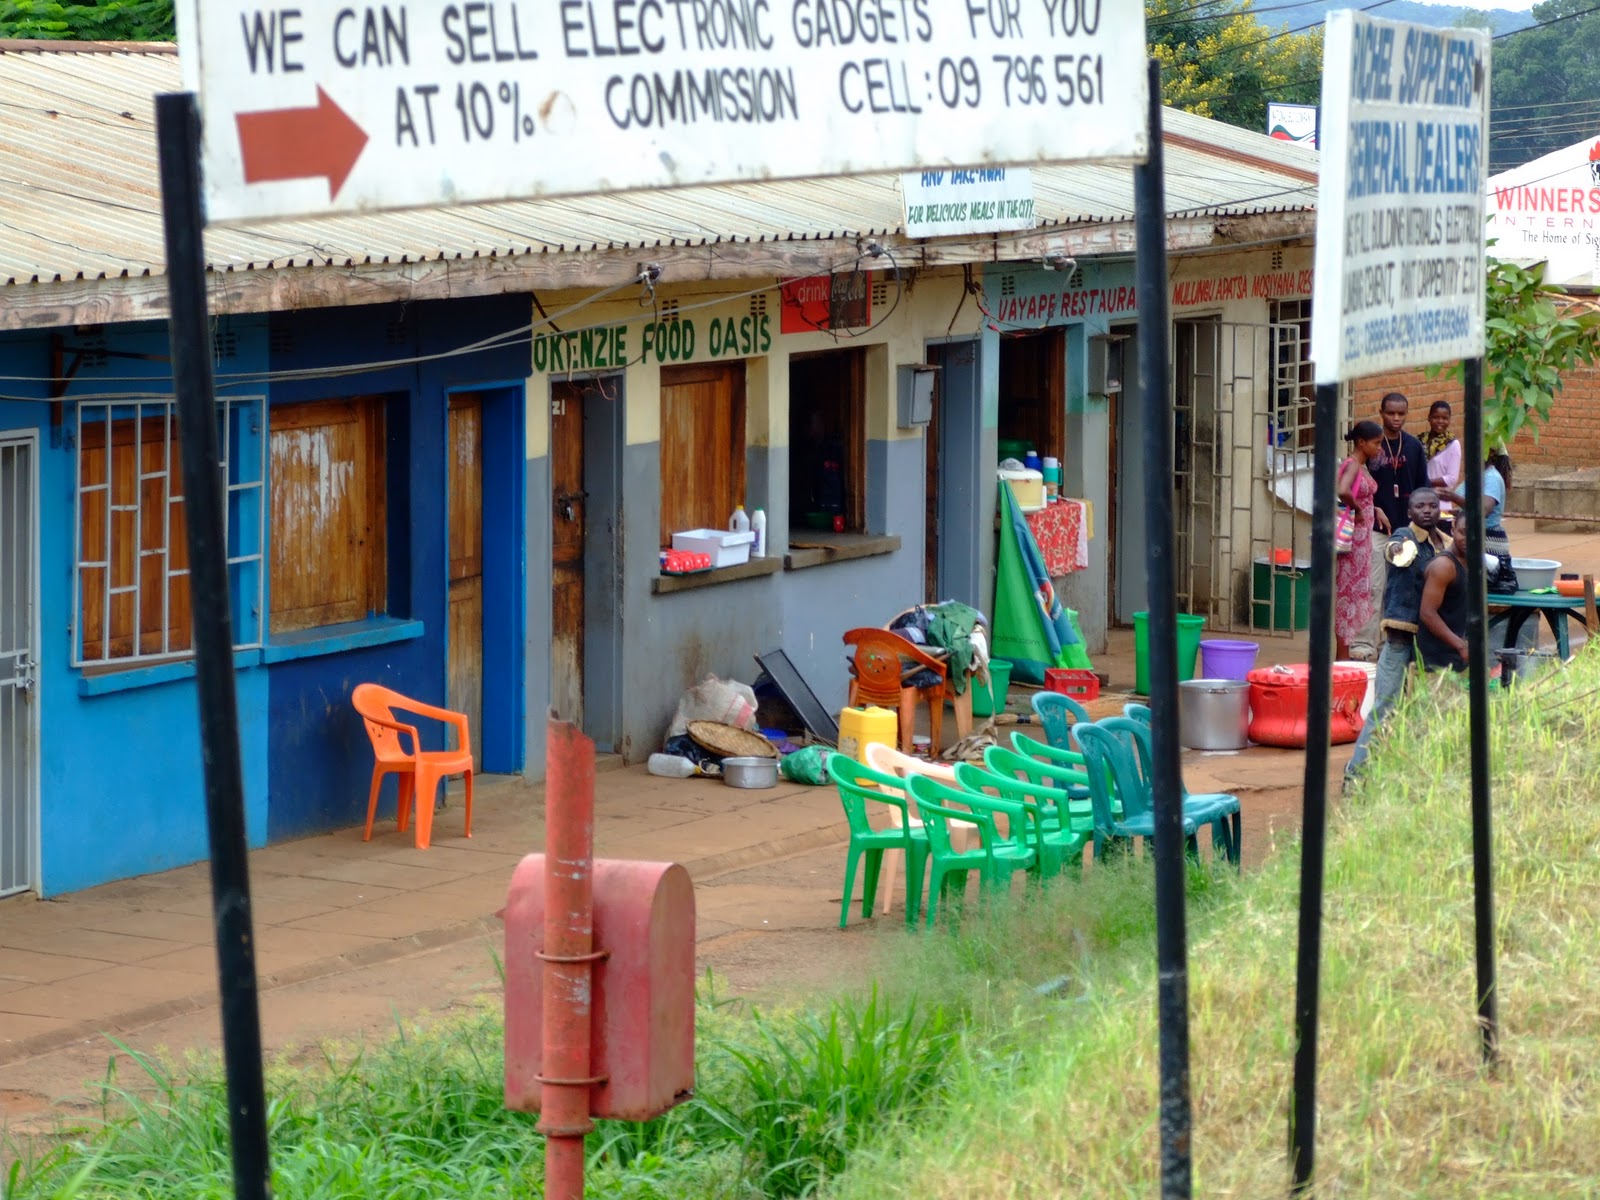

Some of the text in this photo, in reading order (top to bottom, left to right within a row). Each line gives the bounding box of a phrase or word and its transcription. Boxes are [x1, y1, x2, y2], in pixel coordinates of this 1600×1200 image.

[241, 0, 1099, 74] WE CAN SELL ELECTRONIC GADGETS FOR YOU
[1399, 27, 1475, 109] SUPPLIERS
[396, 84, 440, 148] AT
[456, 80, 535, 144] 10%
[604, 65, 800, 130] COMMISSION
[1414, 120, 1480, 196] DEALERS
[908, 205, 924, 225] FOR
[926, 202, 967, 223] DELICIOUS
[969, 201, 996, 220] MEALS
[997, 200, 1005, 219] IN
[1006, 199, 1018, 219] THE
[1494, 185, 1600, 214] WINNERS
[1521, 229, 1539, 243] The
[1542, 230, 1568, 244] Home
[1571, 231, 1582, 244] of
[797, 280, 829, 303] drink
[1061, 286, 1139, 318] RESTAURA
[1216, 275, 1248, 302] APATSA
[642, 317, 696, 364] FOOD
[709, 314, 772, 358] OASIS
